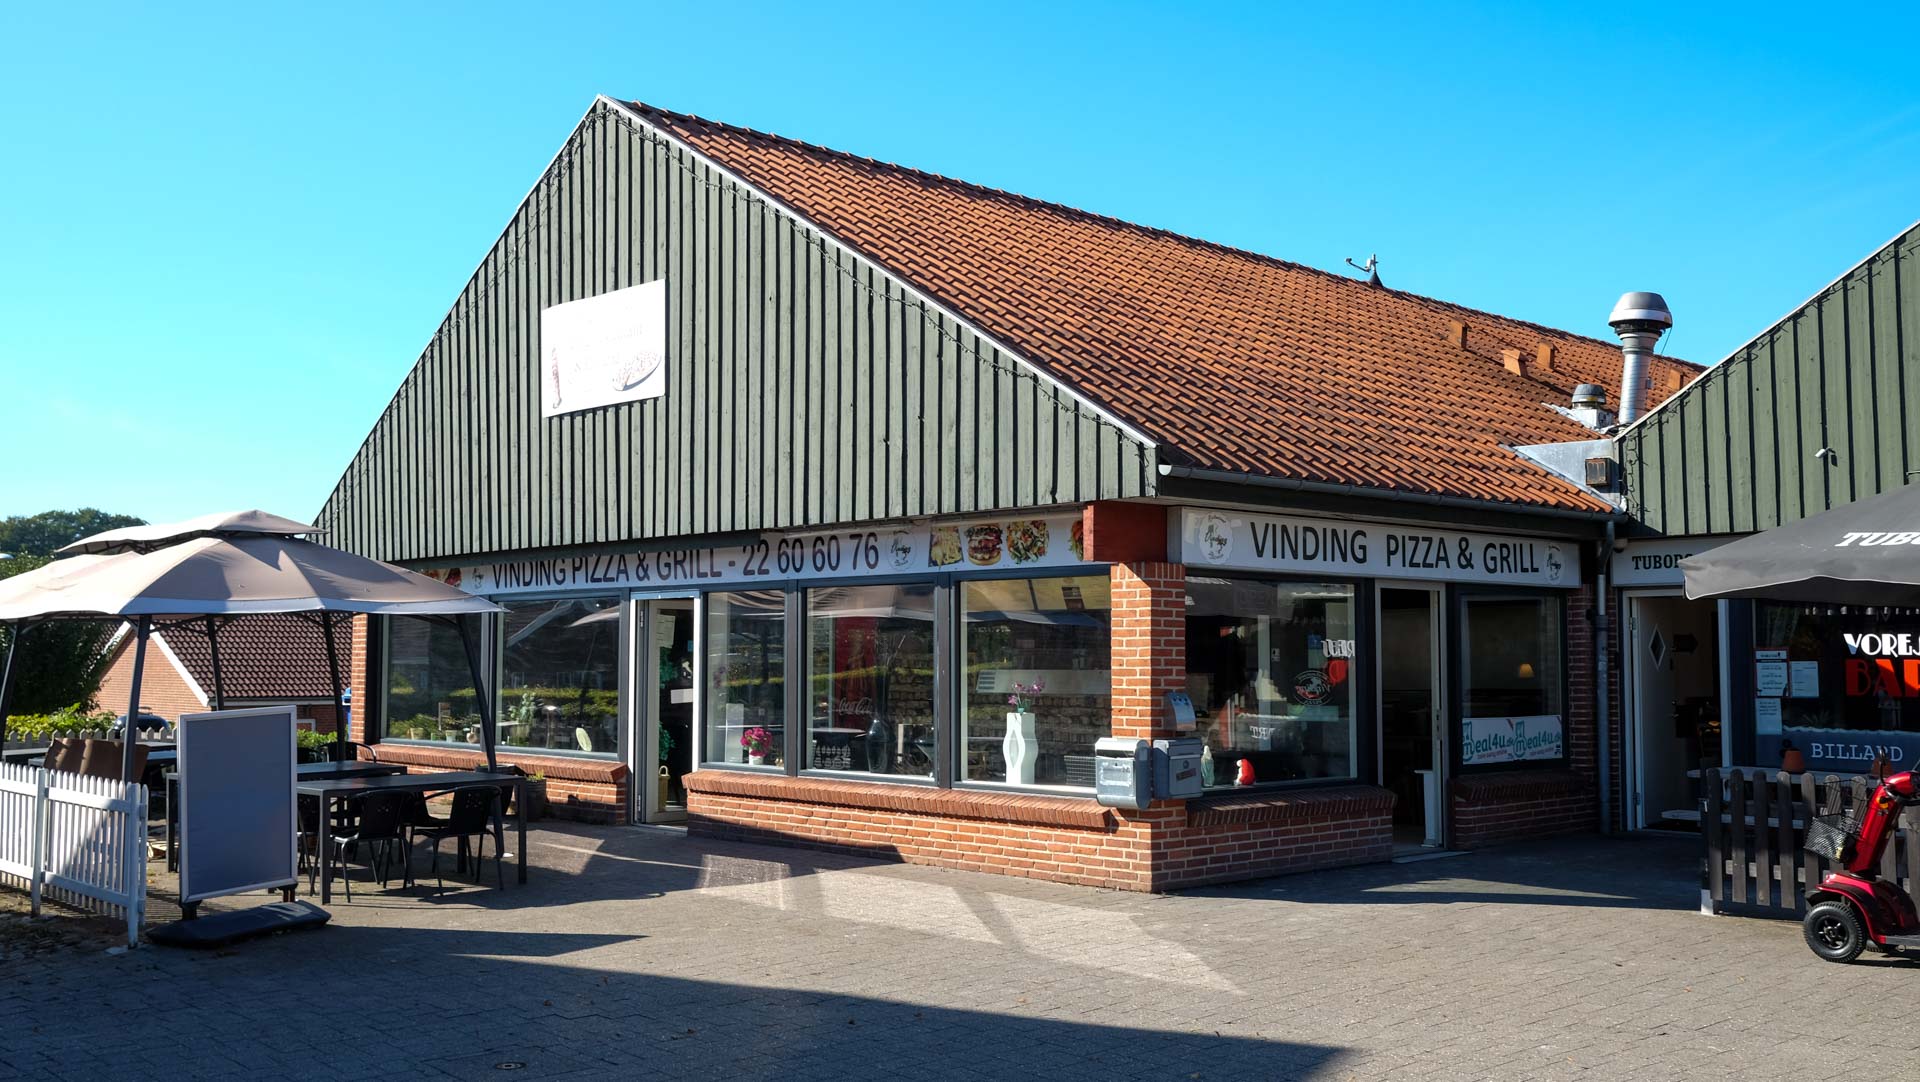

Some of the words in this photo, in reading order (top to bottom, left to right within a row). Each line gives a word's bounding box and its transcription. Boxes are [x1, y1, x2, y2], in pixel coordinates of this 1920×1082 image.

[492, 558, 567, 589] VINDING
[572, 554, 630, 584] PIZZA
[635, 551, 650, 582] &
[656, 547, 722, 580] GRILL
[742, 538, 770, 576] 22
[777, 537, 804, 574] 60
[812, 534, 840, 572] 60
[849, 531, 880, 570] 76
[1249, 521, 1367, 564] VINDING
[1386, 534, 1450, 569] PIZZA
[1457, 537, 1474, 570] &
[1483, 542, 1539, 574] GRILL
[1632, 553, 1693, 570] TUBOR
